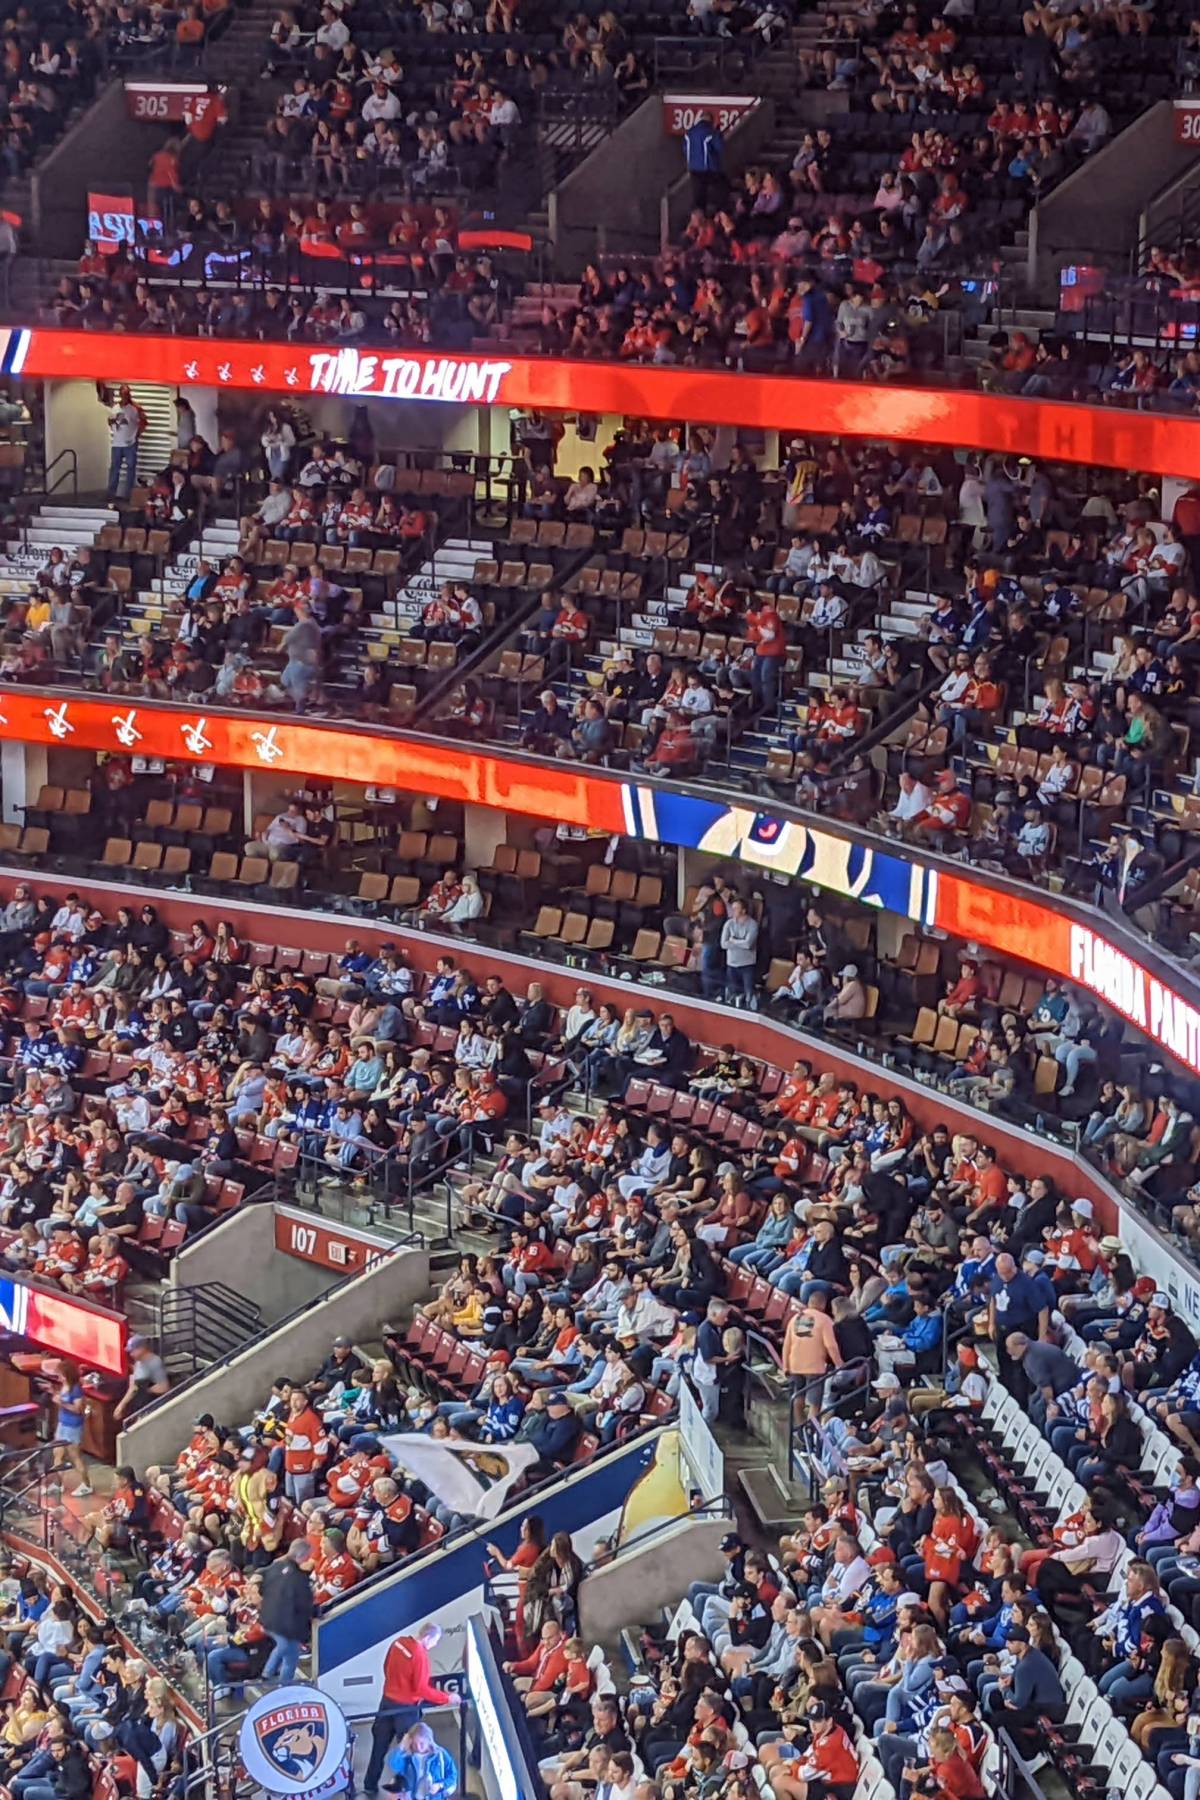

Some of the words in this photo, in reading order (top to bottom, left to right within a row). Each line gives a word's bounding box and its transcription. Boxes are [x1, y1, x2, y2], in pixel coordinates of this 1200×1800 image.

[135, 96, 169, 116] 305
[310, 348, 378, 393] TIME
[382, 359, 420, 395] TO
[421, 359, 512, 402] HUNT
[1070, 924, 1147, 1027] FLORIDA
[291, 1224, 317, 1255] 107
[260, 1706, 320, 1731] FLORIDA
